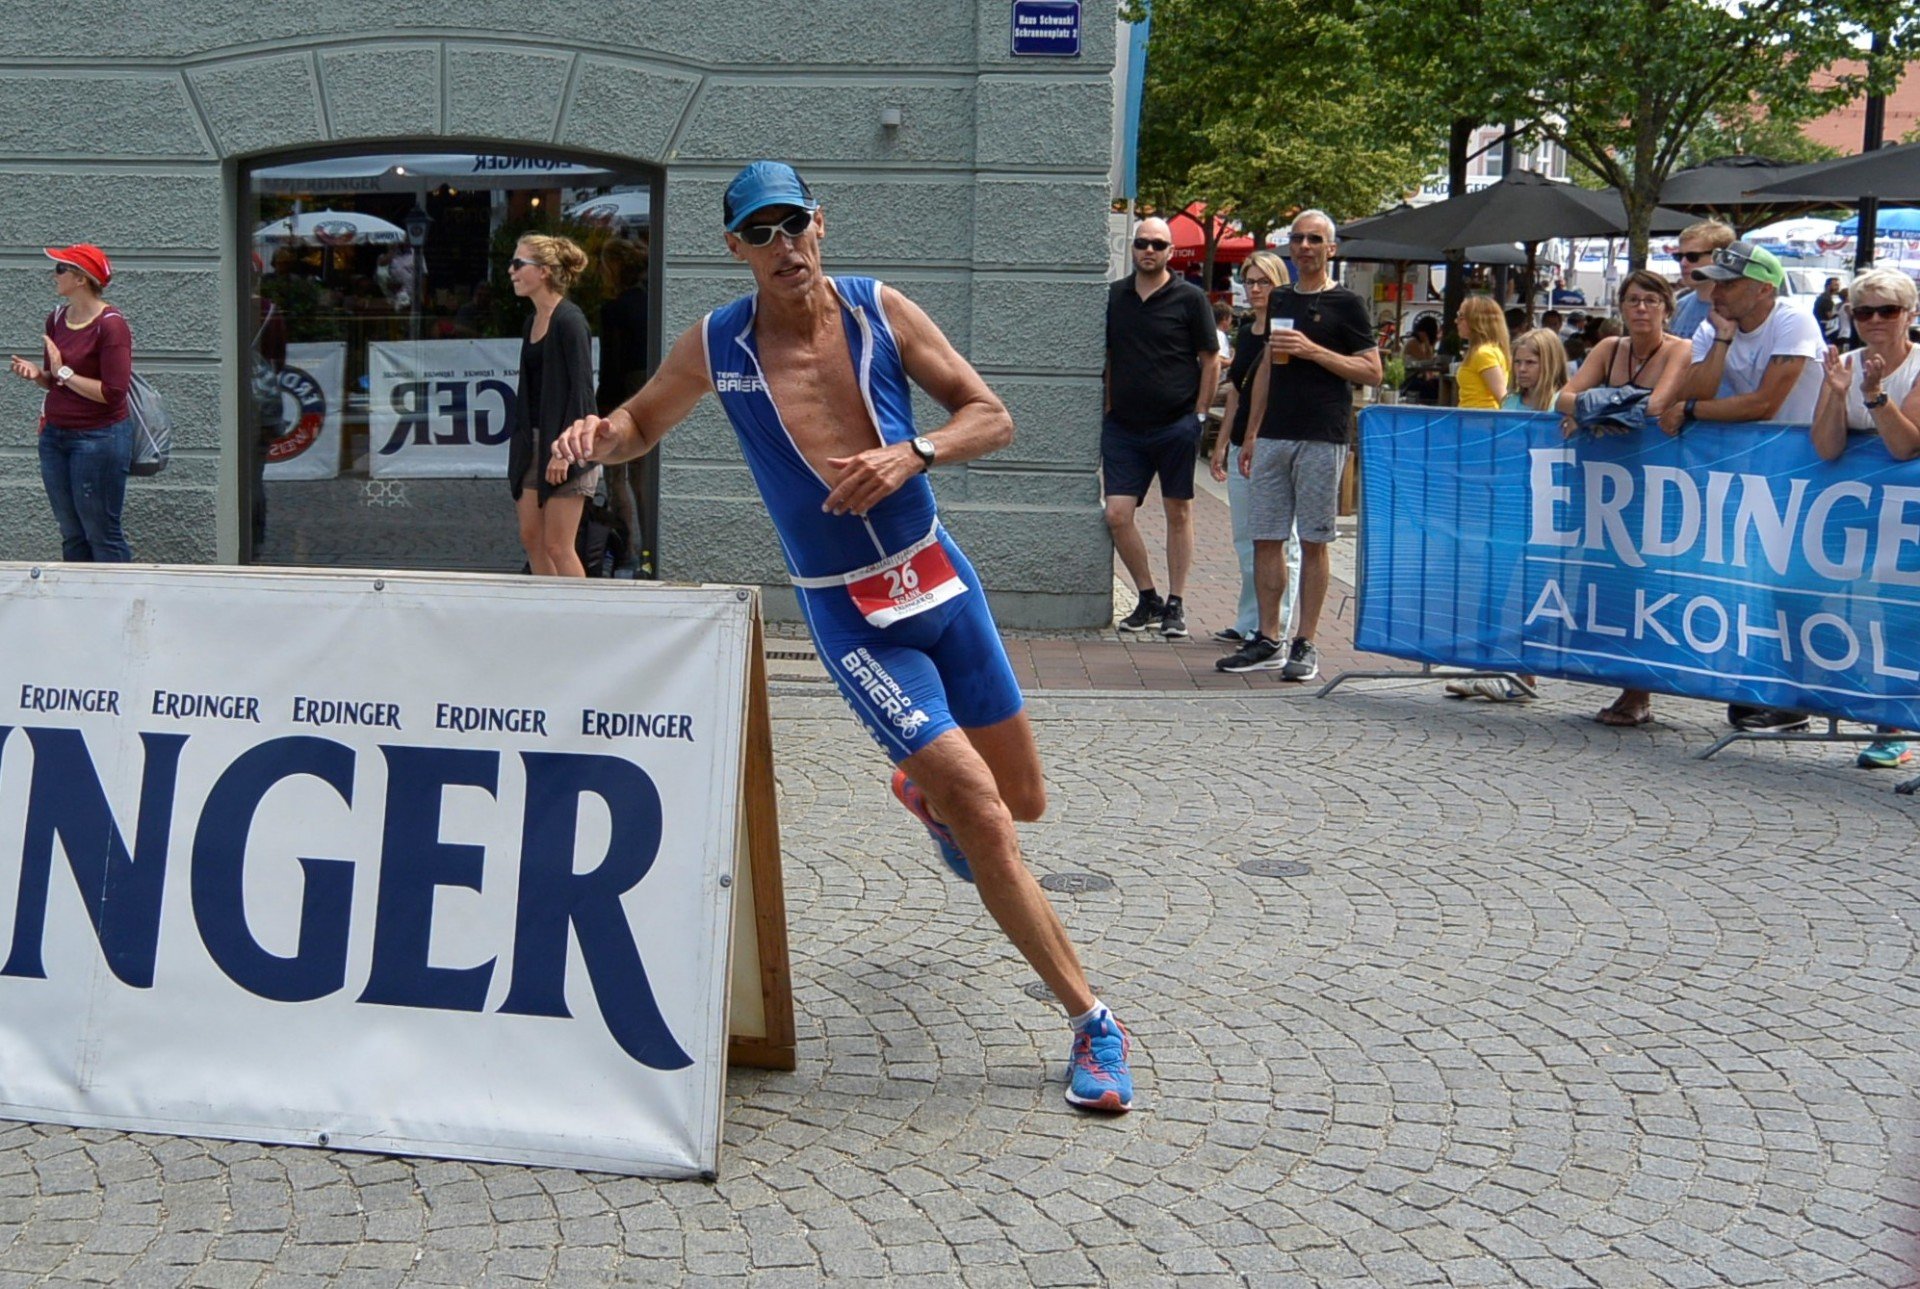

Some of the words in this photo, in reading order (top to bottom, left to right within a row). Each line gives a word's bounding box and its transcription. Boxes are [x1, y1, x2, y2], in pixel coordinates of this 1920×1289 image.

[1015, 28, 1070, 39] Schrannenplatz
[1019, 15, 1037, 25] Haus
[717, 379, 766, 392] BAIER
[1527, 448, 1920, 587] ERDINGE
[883, 561, 919, 598] 26
[1524, 579, 1920, 681] ALKOHOL
[841, 651, 902, 719] BAIER
[857, 647, 912, 707] BIKEWORLD
[20, 684, 120, 715] ERDINGER
[152, 690, 260, 723] ERDINGER
[292, 697, 402, 730] ERDINGER
[436, 703, 548, 736] ERDINGER
[581, 709, 694, 742] ERDINGER
